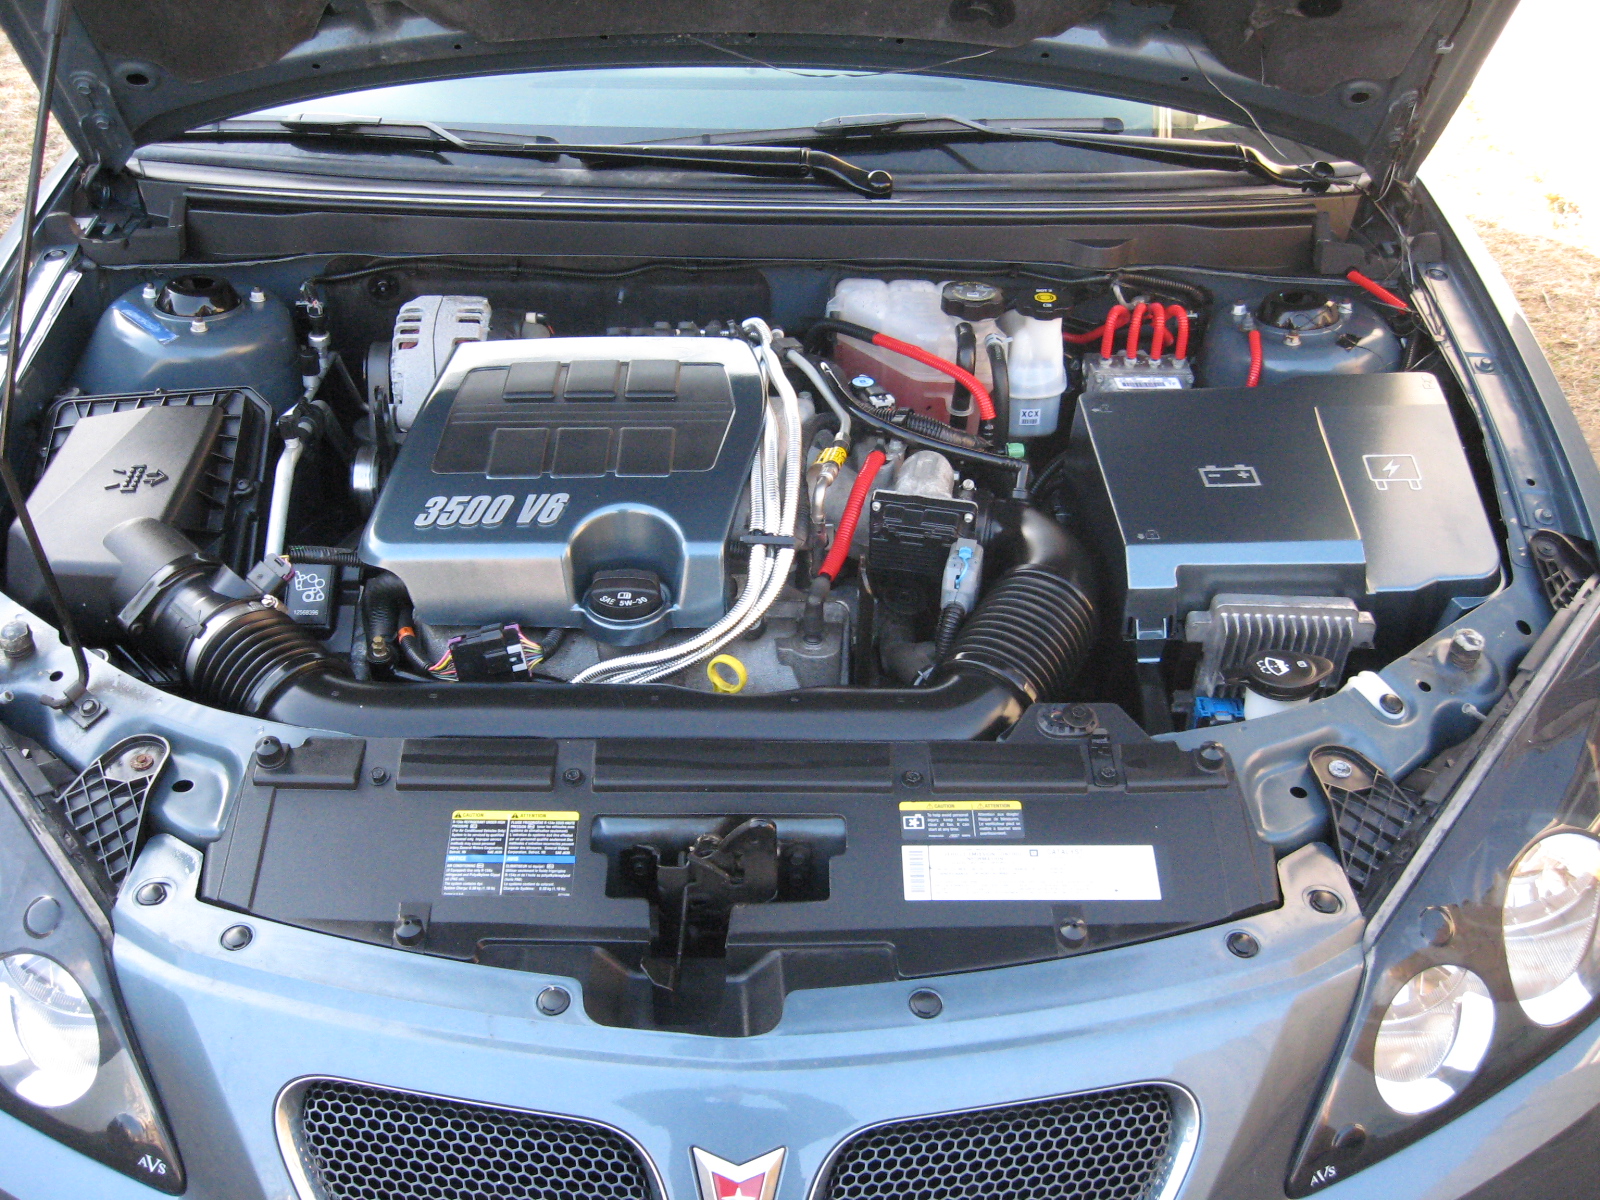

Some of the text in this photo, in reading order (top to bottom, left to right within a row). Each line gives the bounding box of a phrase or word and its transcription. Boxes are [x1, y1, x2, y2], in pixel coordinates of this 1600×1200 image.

[414, 493, 570, 529] 3500 V6
[600, 595, 648, 606] SAE 5W-30
[137, 1154, 166, 1174] AVS
[1310, 1165, 1336, 1186] AVS
